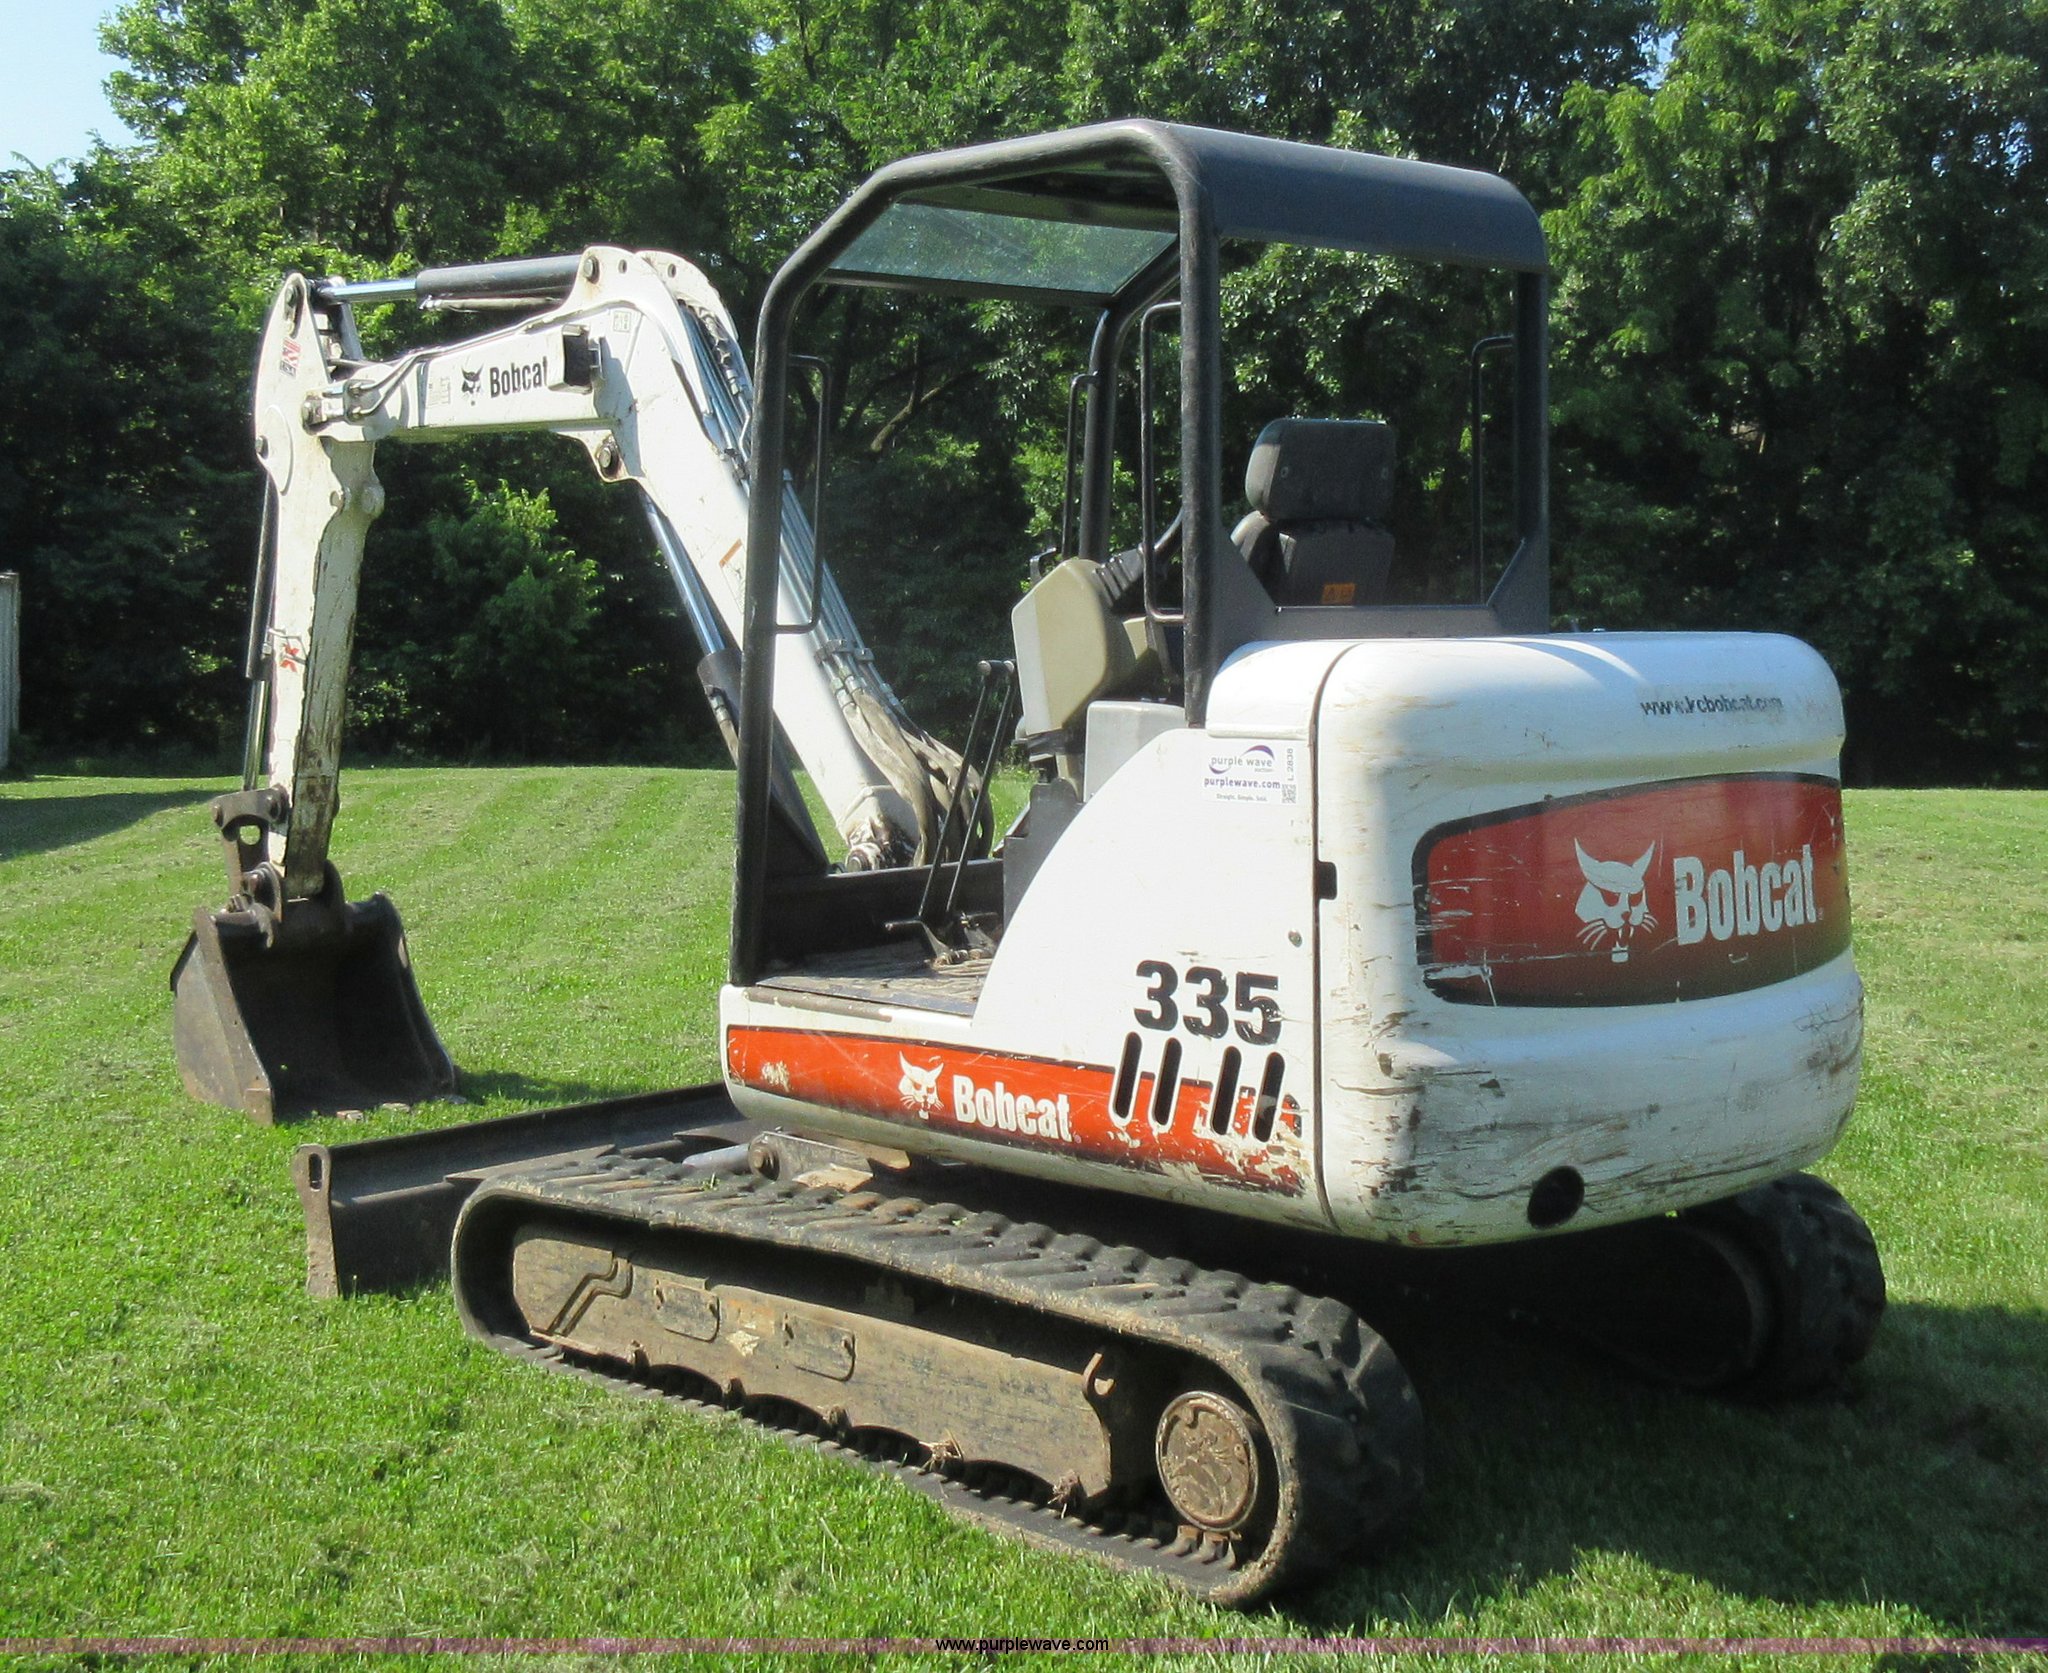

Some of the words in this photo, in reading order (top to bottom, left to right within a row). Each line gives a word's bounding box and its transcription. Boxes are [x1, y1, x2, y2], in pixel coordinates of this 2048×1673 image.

[489, 355, 548, 399] Bobcat
[1204, 776, 1281, 789] purplewave.com
[1211, 755, 1243, 766] purple
[1246, 757, 1273, 768] wave
[1673, 843, 1817, 946] Bobcat
[1133, 959, 1282, 1046] 335
[952, 1074, 1073, 1143] Bobcat
